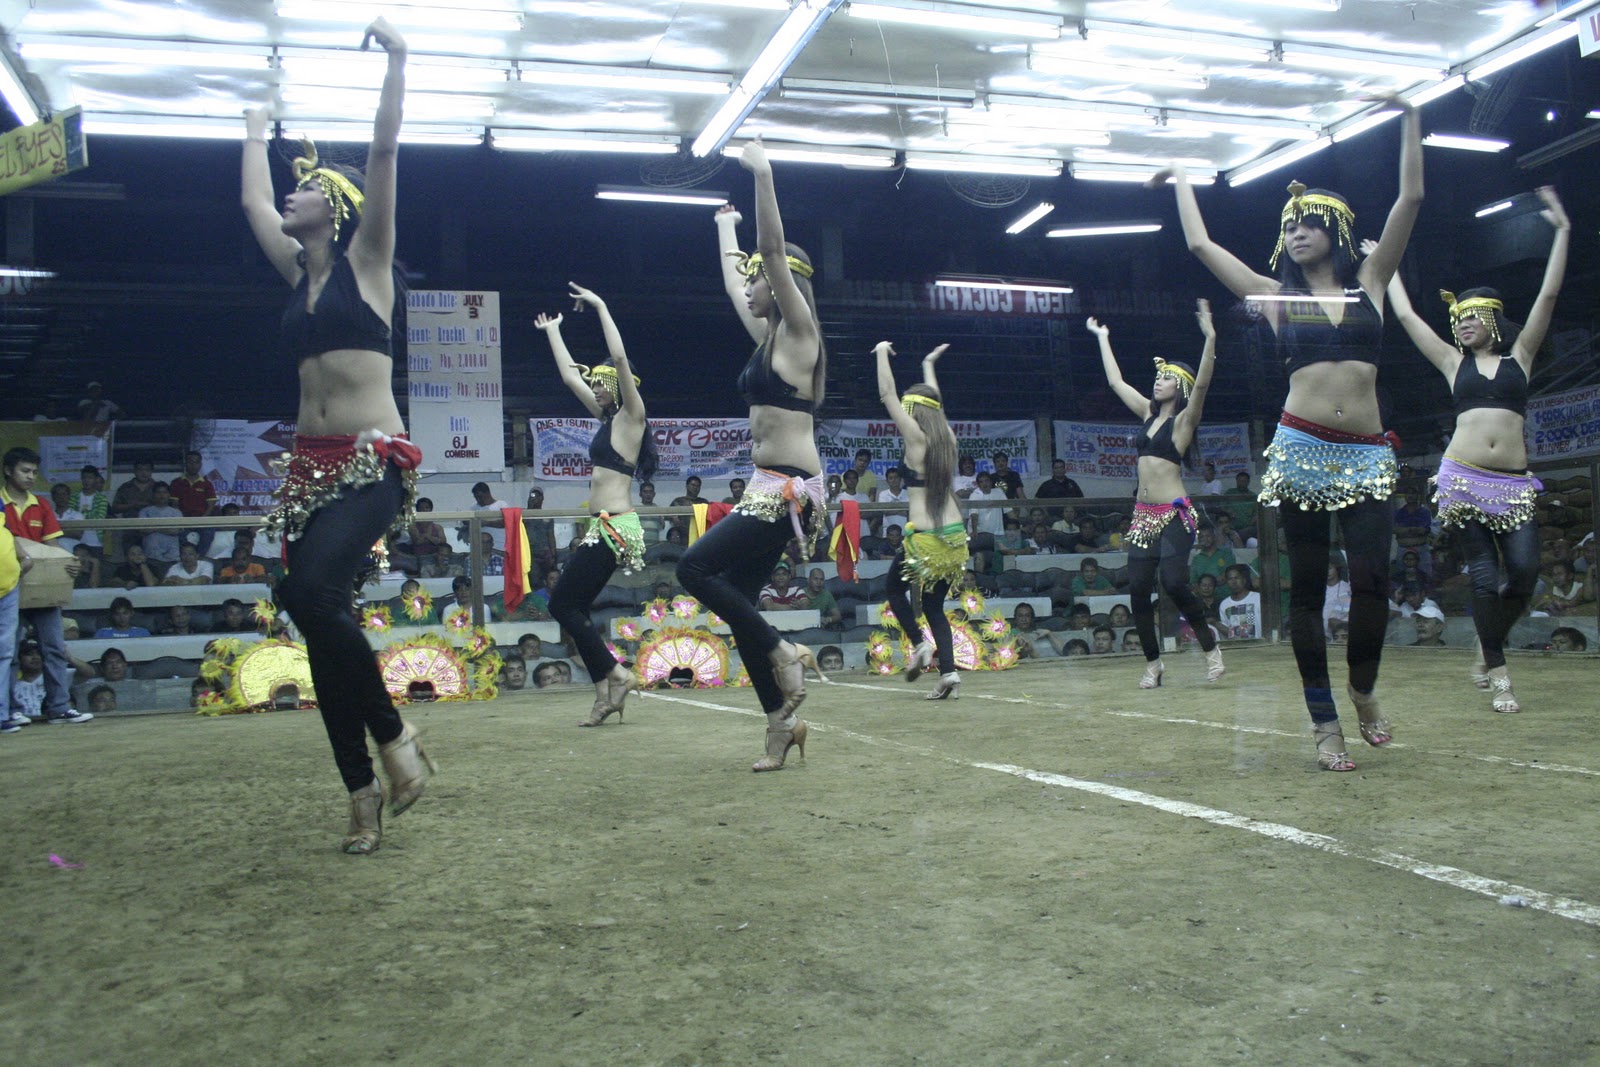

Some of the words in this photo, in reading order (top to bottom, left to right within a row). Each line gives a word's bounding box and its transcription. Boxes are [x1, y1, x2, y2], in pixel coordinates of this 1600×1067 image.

[463, 294, 485, 307] JULY
[277, 423, 297, 432] Roli
[681, 420, 728, 428] COCKPIT
[653, 430, 685, 446] CK
[712, 429, 746, 442] COCK
[444, 450, 480, 459] COMBINE
[541, 458, 593, 467] JIMMY
[542, 467, 593, 476] OLALIA
